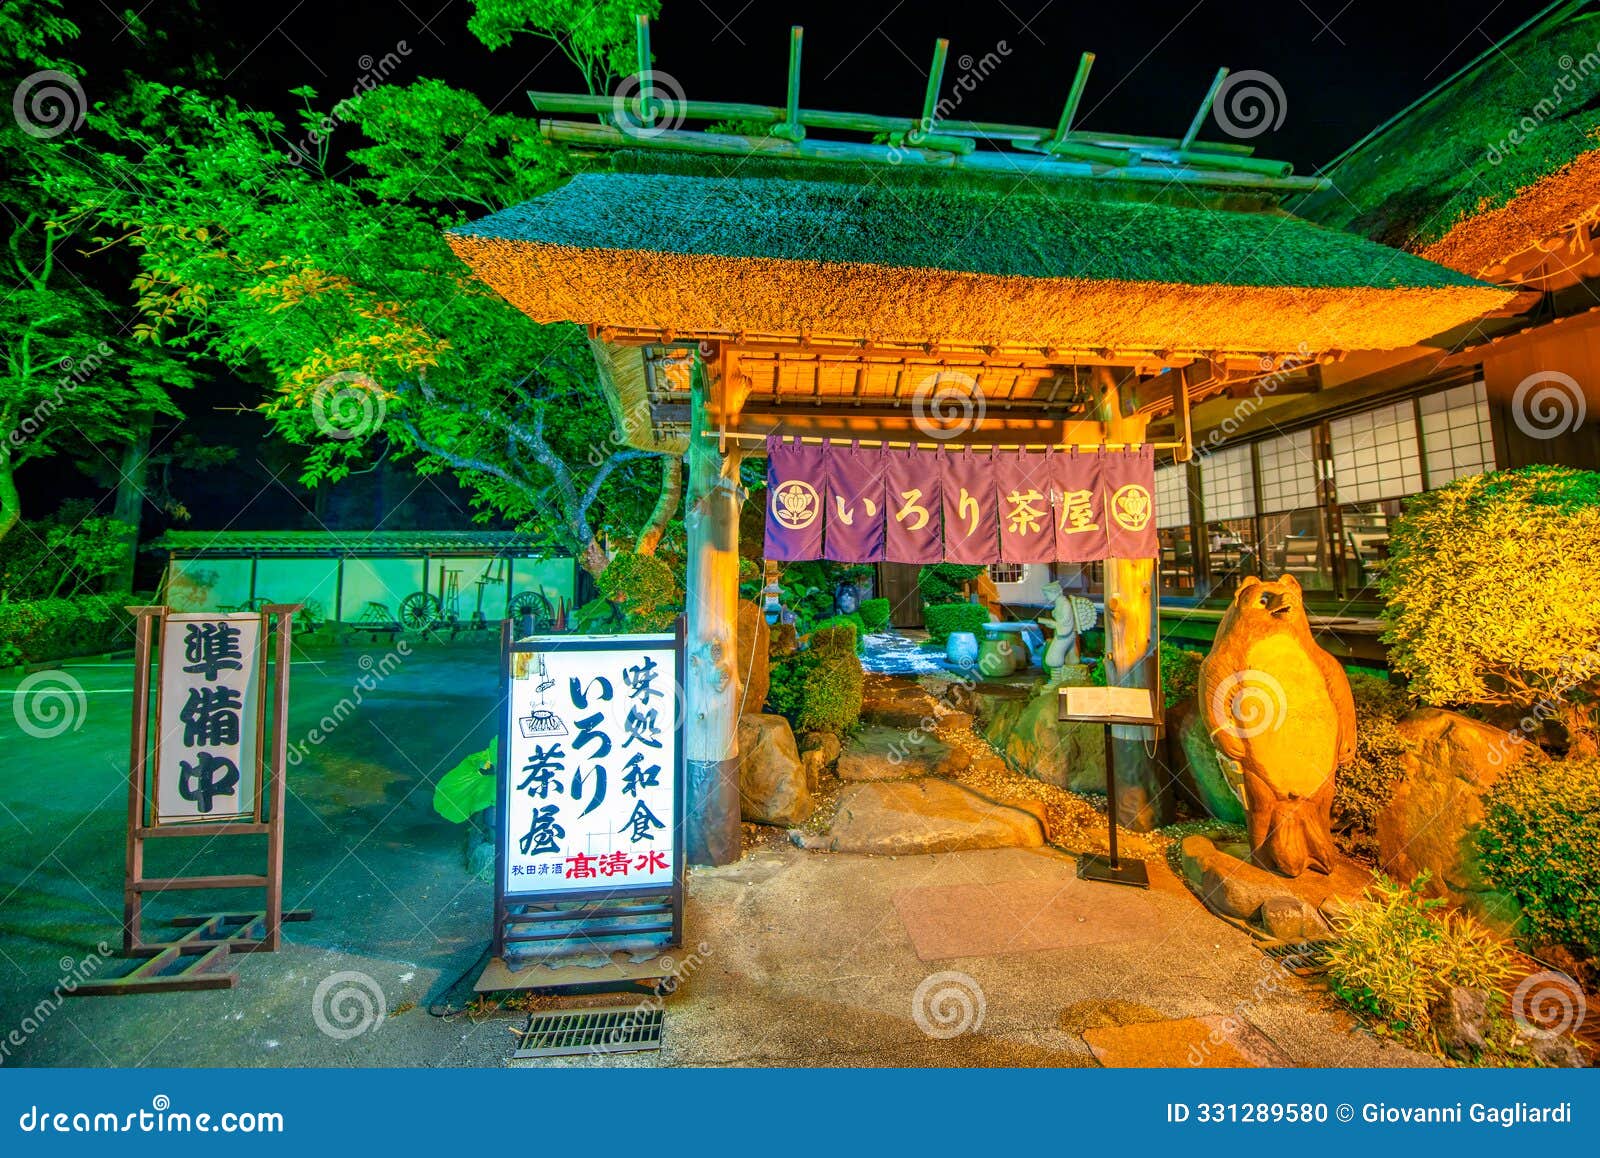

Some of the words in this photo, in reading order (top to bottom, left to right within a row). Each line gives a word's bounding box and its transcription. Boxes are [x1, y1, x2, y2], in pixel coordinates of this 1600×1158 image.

[835, 487, 1100, 537] いろり茶屋
[178, 621, 243, 813] 準備中
[569, 676, 614, 820] いろり
[617, 656, 666, 844] 味処和食
[516, 742, 566, 856] 茶屋
[511, 863, 563, 877] 秋田清酒
